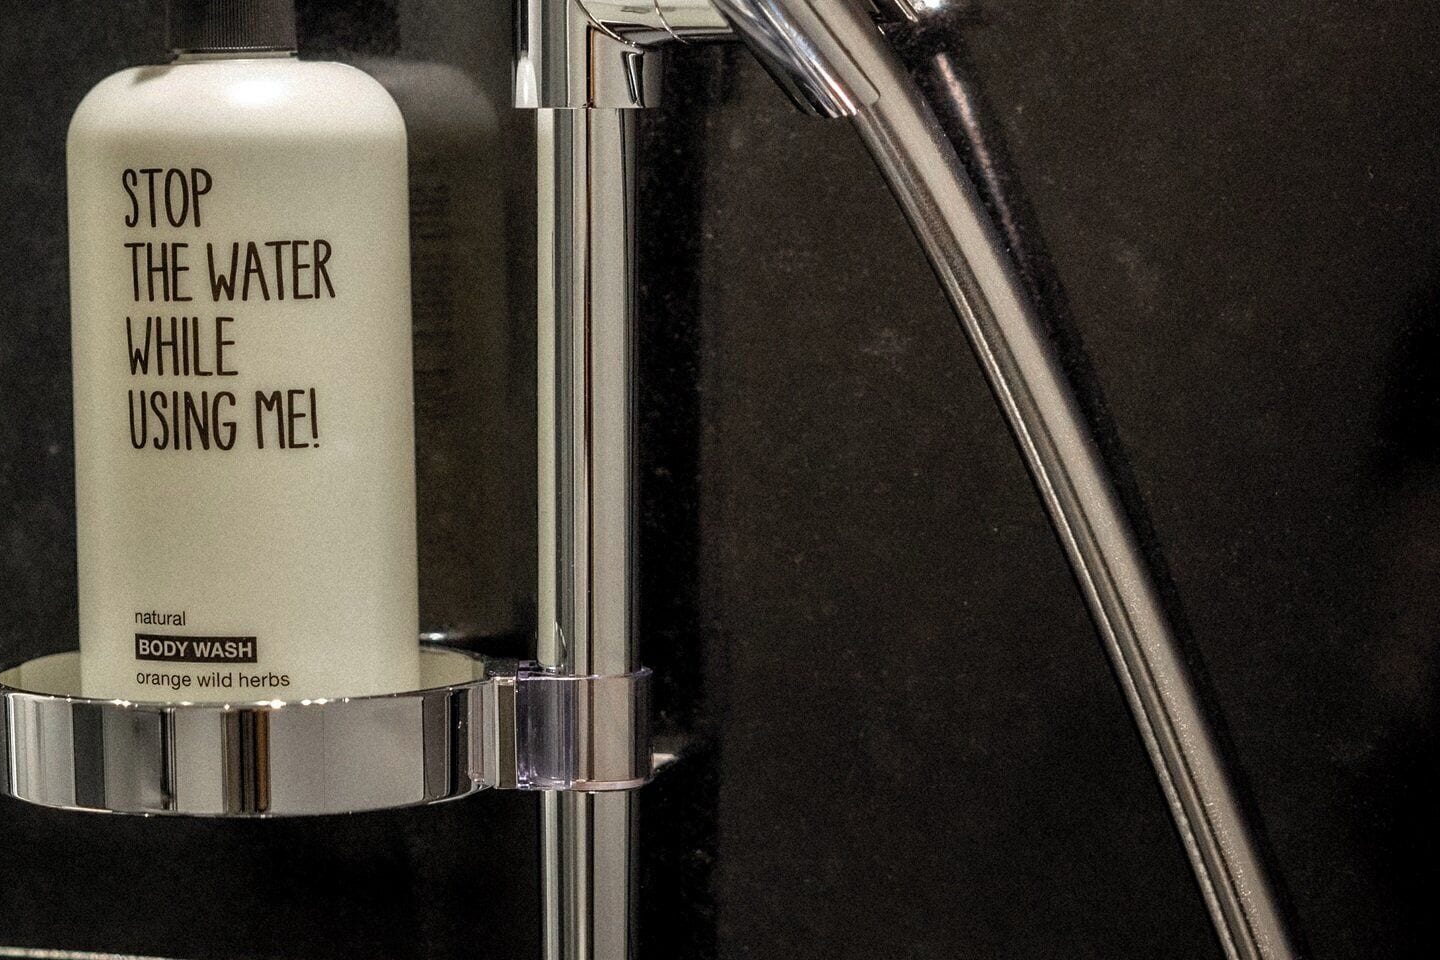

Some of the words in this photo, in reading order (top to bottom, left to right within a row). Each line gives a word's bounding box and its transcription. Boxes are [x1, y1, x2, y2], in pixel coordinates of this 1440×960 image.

[122, 168, 212, 227] STOP
[124, 242, 193, 302] THE
[206, 239, 336, 301] WATER
[126, 316, 239, 376] WHILE
[128, 389, 237, 451] USING
[255, 387, 320, 449] ME!
[135, 610, 186, 626] natural
[138, 639, 189, 657] BODY
[192, 641, 253, 658] WASH
[136, 671, 191, 690] orange
[196, 672, 232, 688] wild
[238, 672, 291, 688] herbs
